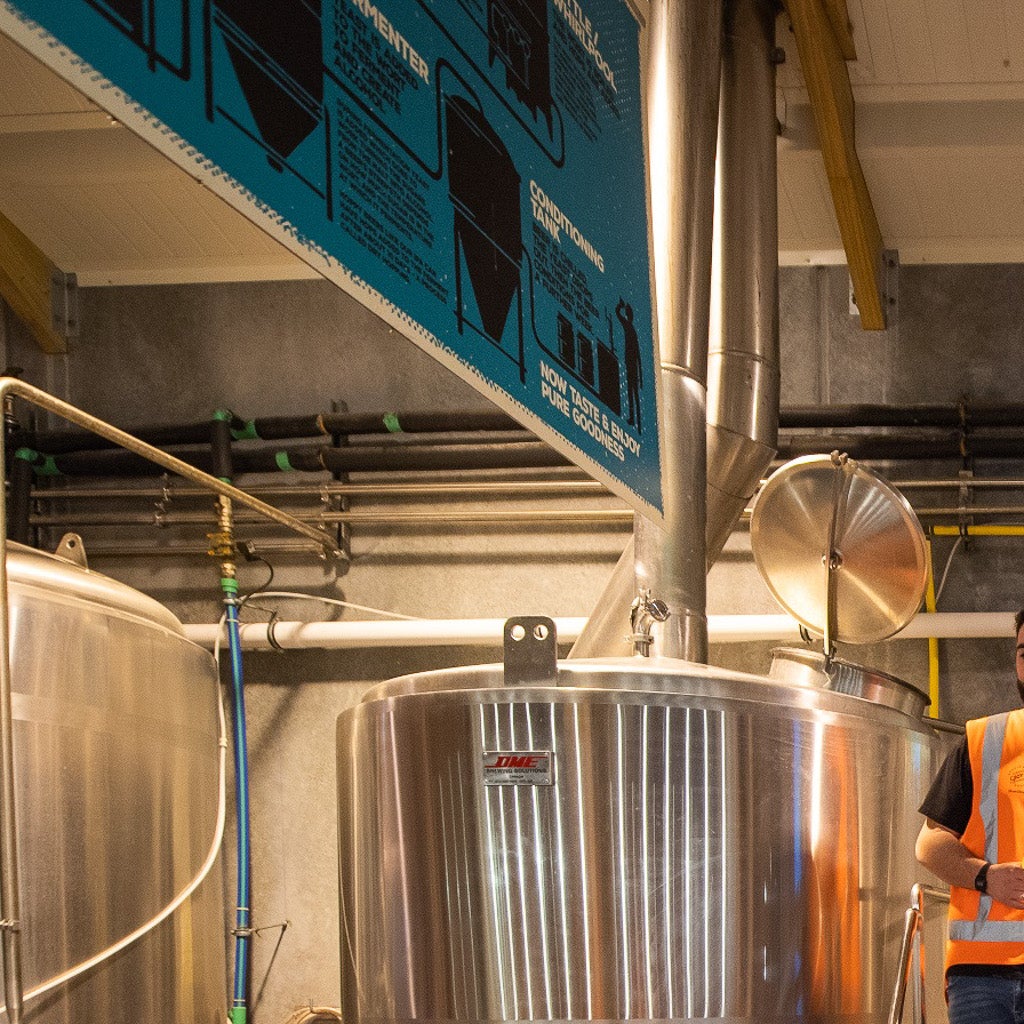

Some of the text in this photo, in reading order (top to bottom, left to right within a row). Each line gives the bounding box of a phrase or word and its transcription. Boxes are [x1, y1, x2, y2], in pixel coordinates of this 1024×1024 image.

[530, 197, 561, 244] TANK
[530, 179, 605, 273] CONDITIONING
[540, 360, 641, 457] NOW TASTE & ENJOY
[541, 380, 625, 462] PURE GOODNESS
[485, 756, 548, 768] DME
